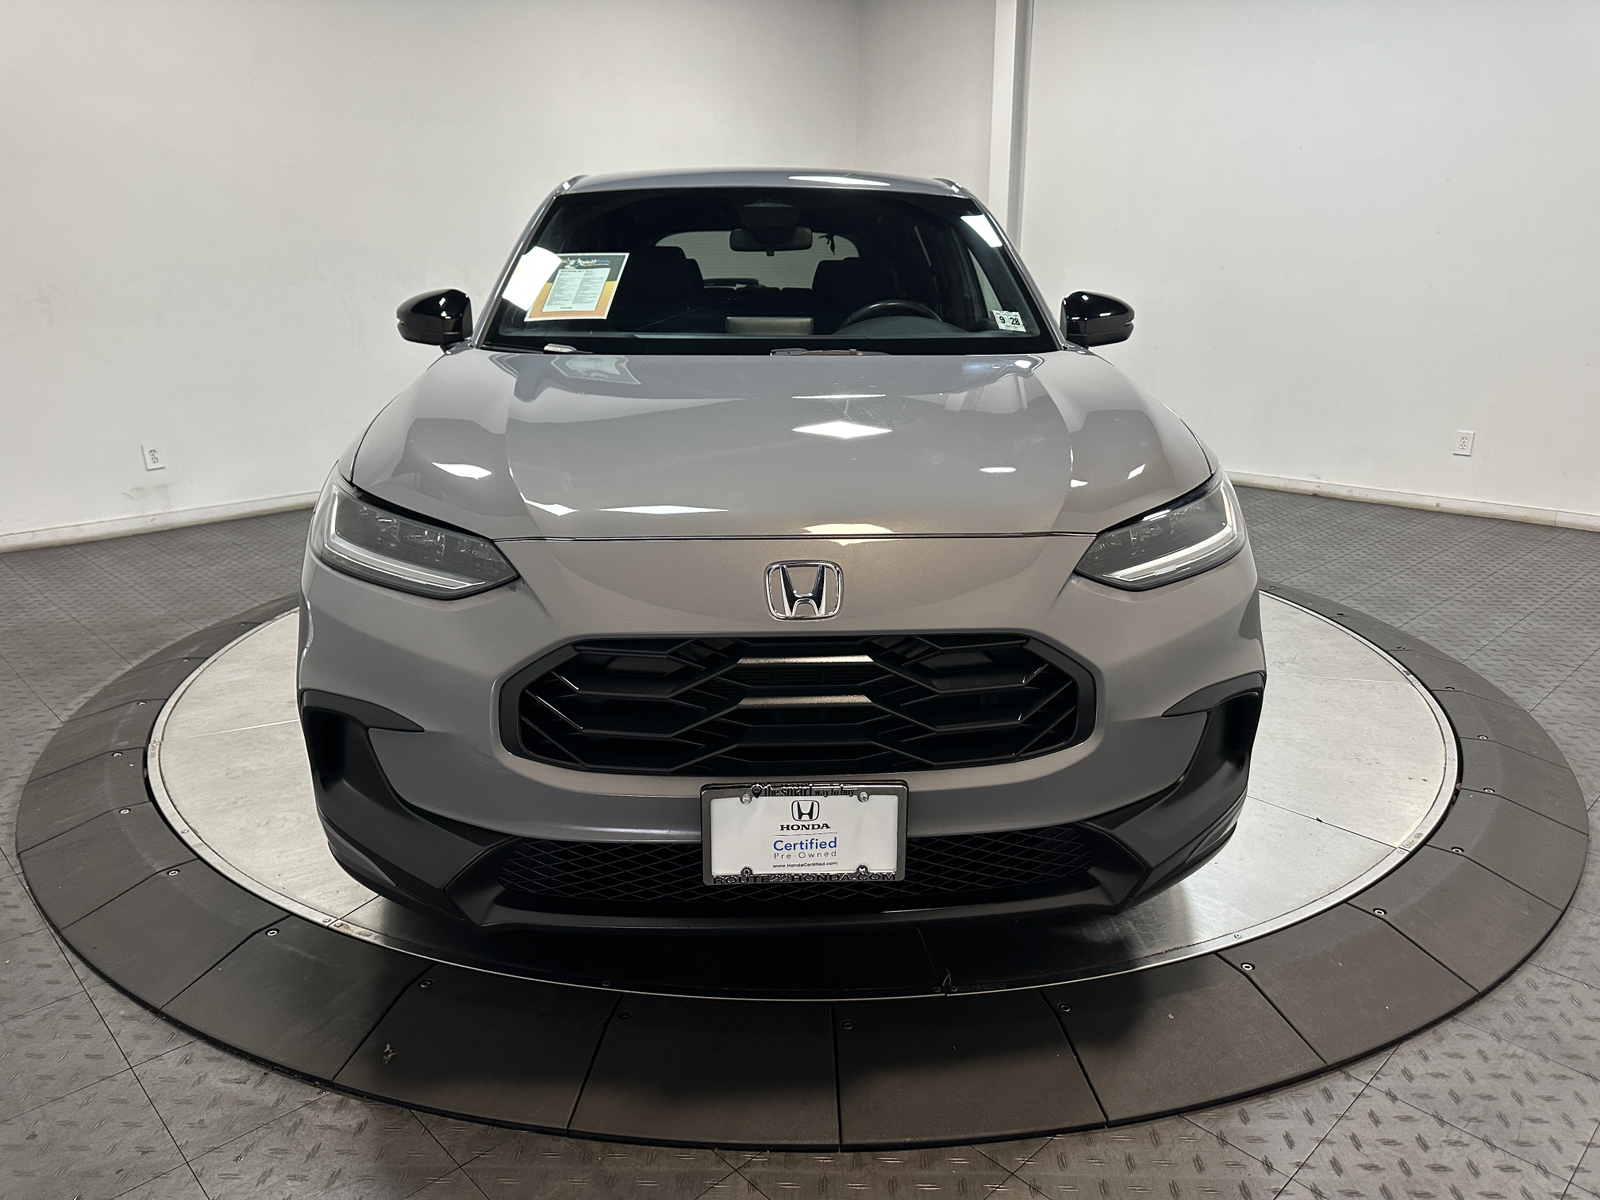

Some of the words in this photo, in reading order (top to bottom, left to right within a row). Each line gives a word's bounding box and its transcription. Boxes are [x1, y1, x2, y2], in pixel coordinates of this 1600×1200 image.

[1010, 317, 1020, 325] 28
[814, 788, 830, 798] way
[831, 786, 840, 796] to
[779, 823, 831, 831] HONDA
[773, 836, 838, 851] Certified
[773, 850, 838, 860] Pre-Owned
